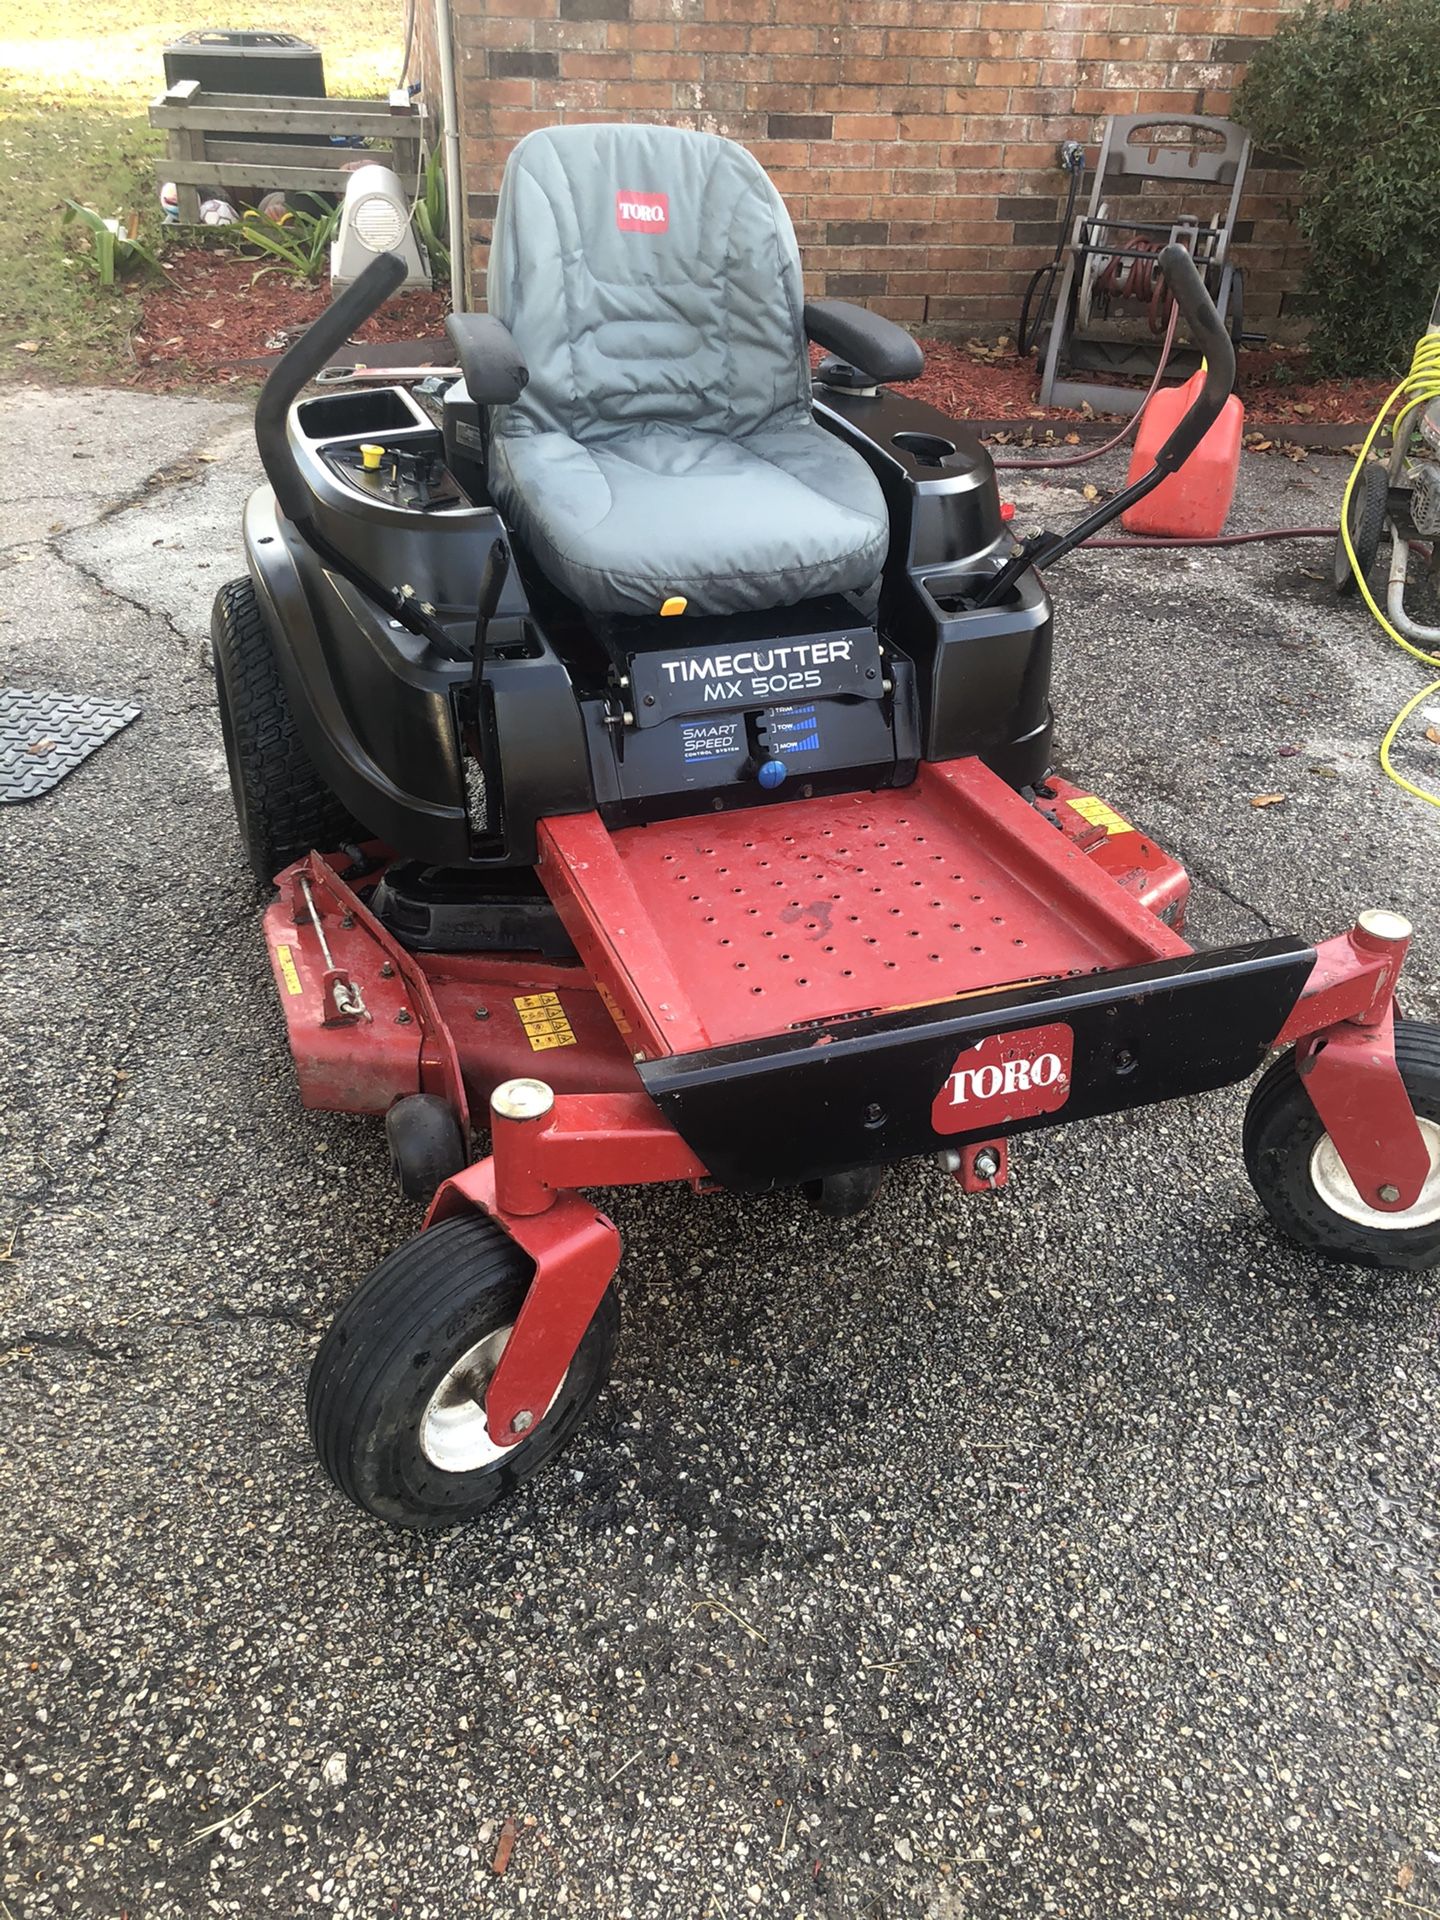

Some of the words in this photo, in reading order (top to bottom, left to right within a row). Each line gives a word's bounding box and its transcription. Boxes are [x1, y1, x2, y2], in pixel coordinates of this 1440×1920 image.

[661, 641, 851, 683] TIMECUTTER
[704, 680, 743, 702] MX
[751, 669, 822, 696] 5025
[775, 706, 793, 714] TRIM
[682, 724, 738, 740] SMART
[684, 736, 733, 751] SPEED
[779, 741, 798, 749] MOW
[684, 750, 713, 758] CONTROL
